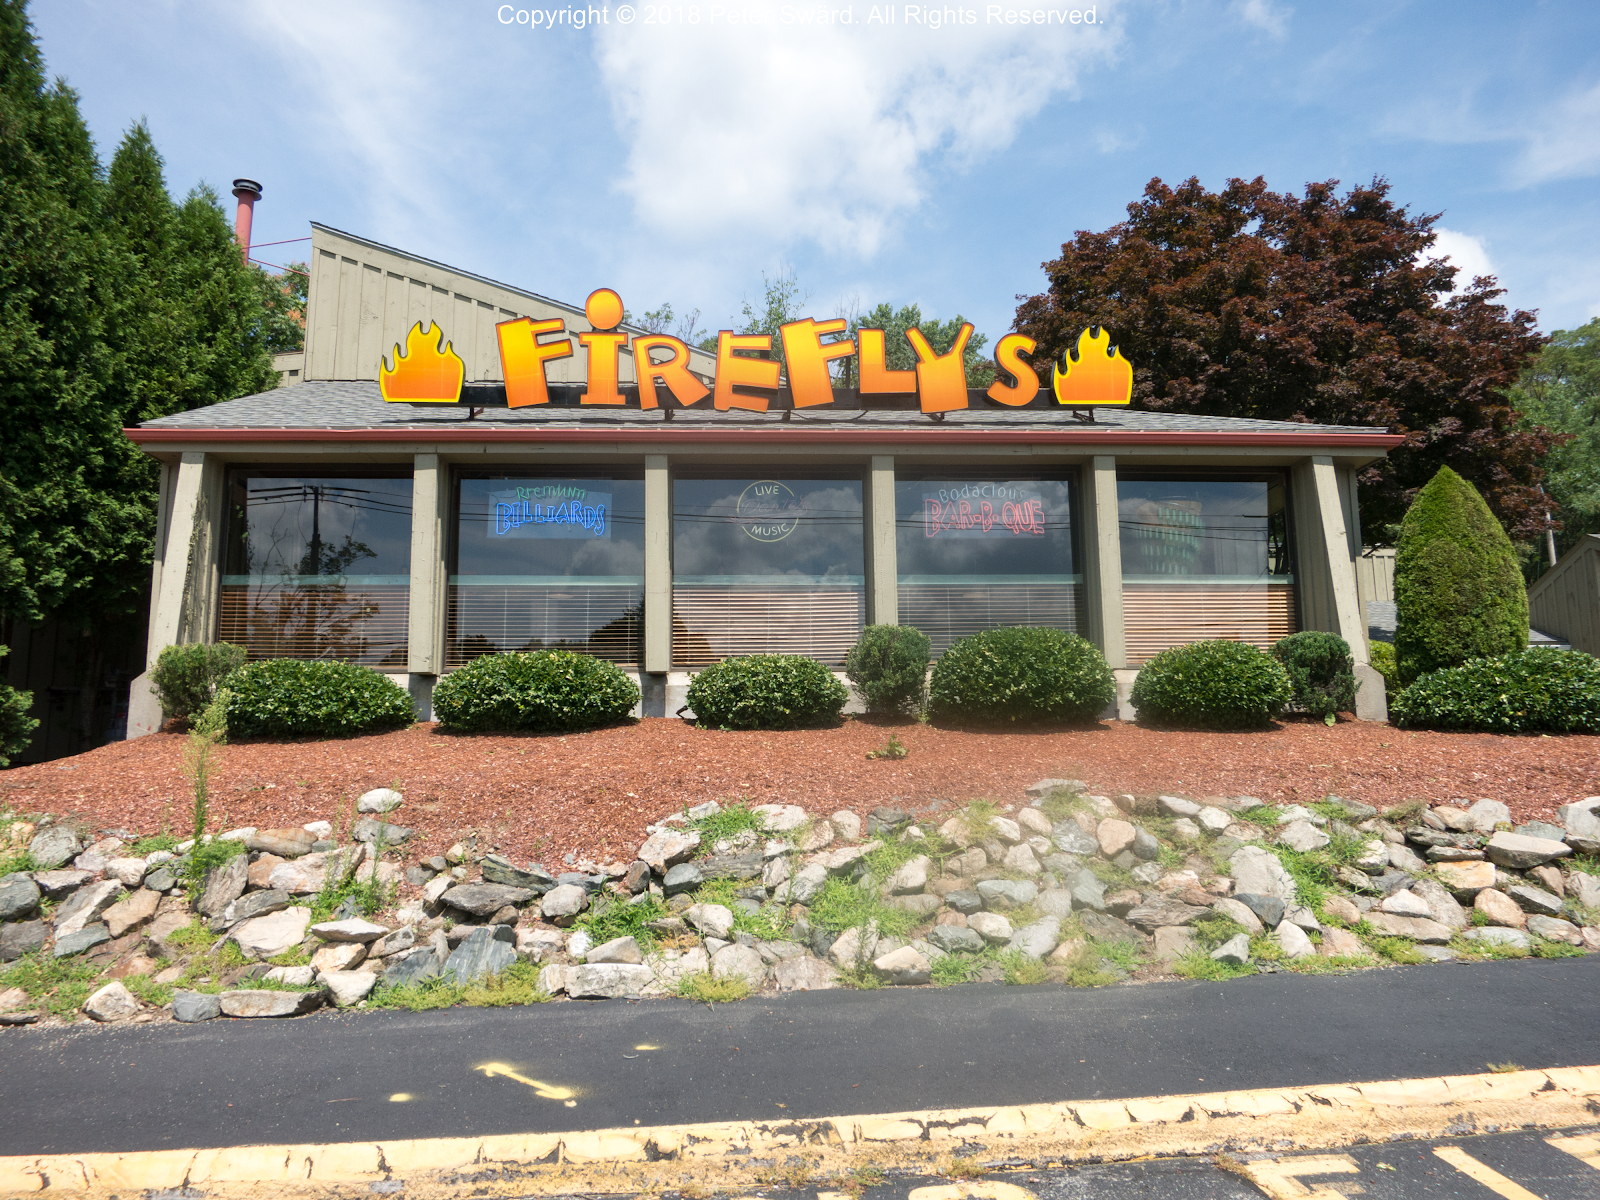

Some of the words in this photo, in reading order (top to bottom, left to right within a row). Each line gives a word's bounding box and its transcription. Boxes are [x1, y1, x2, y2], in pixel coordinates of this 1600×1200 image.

[754, 485, 780, 496] LIVE
[938, 484, 1026, 503] Bodacious
[496, 500, 606, 536] BILLIARDS
[750, 522, 790, 536] MUSIC
